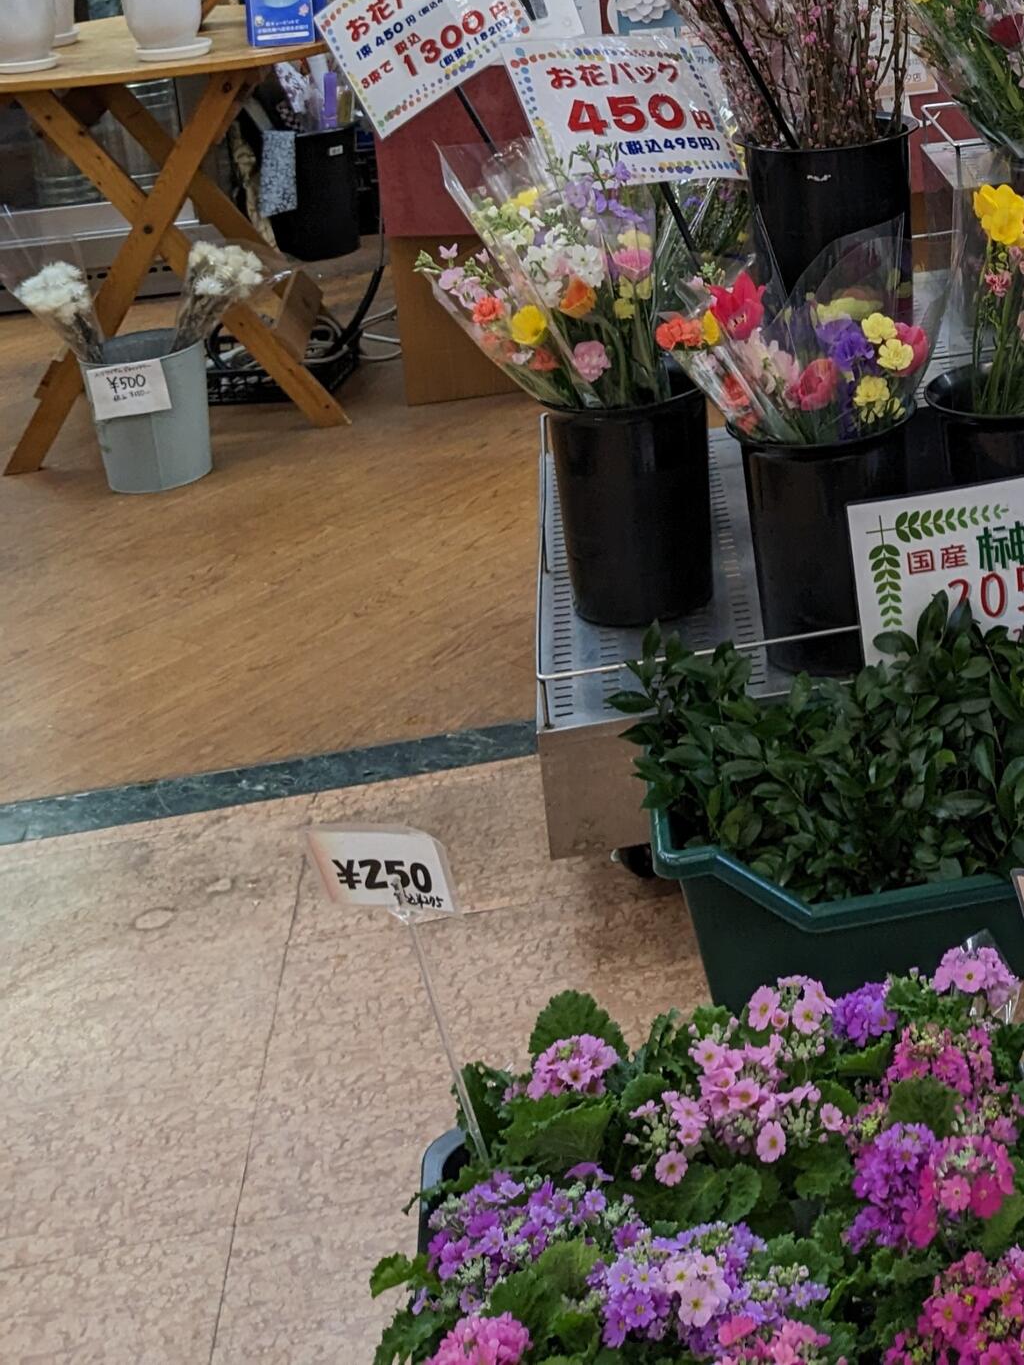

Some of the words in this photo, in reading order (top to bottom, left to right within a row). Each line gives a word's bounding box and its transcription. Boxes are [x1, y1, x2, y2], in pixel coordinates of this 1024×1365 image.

[546, 62, 680, 90] お花パック
[618, 136, 721, 156] (税込495円)
[106, 374, 146, 394] ¥500
[332, 859, 433, 894] ¥250
